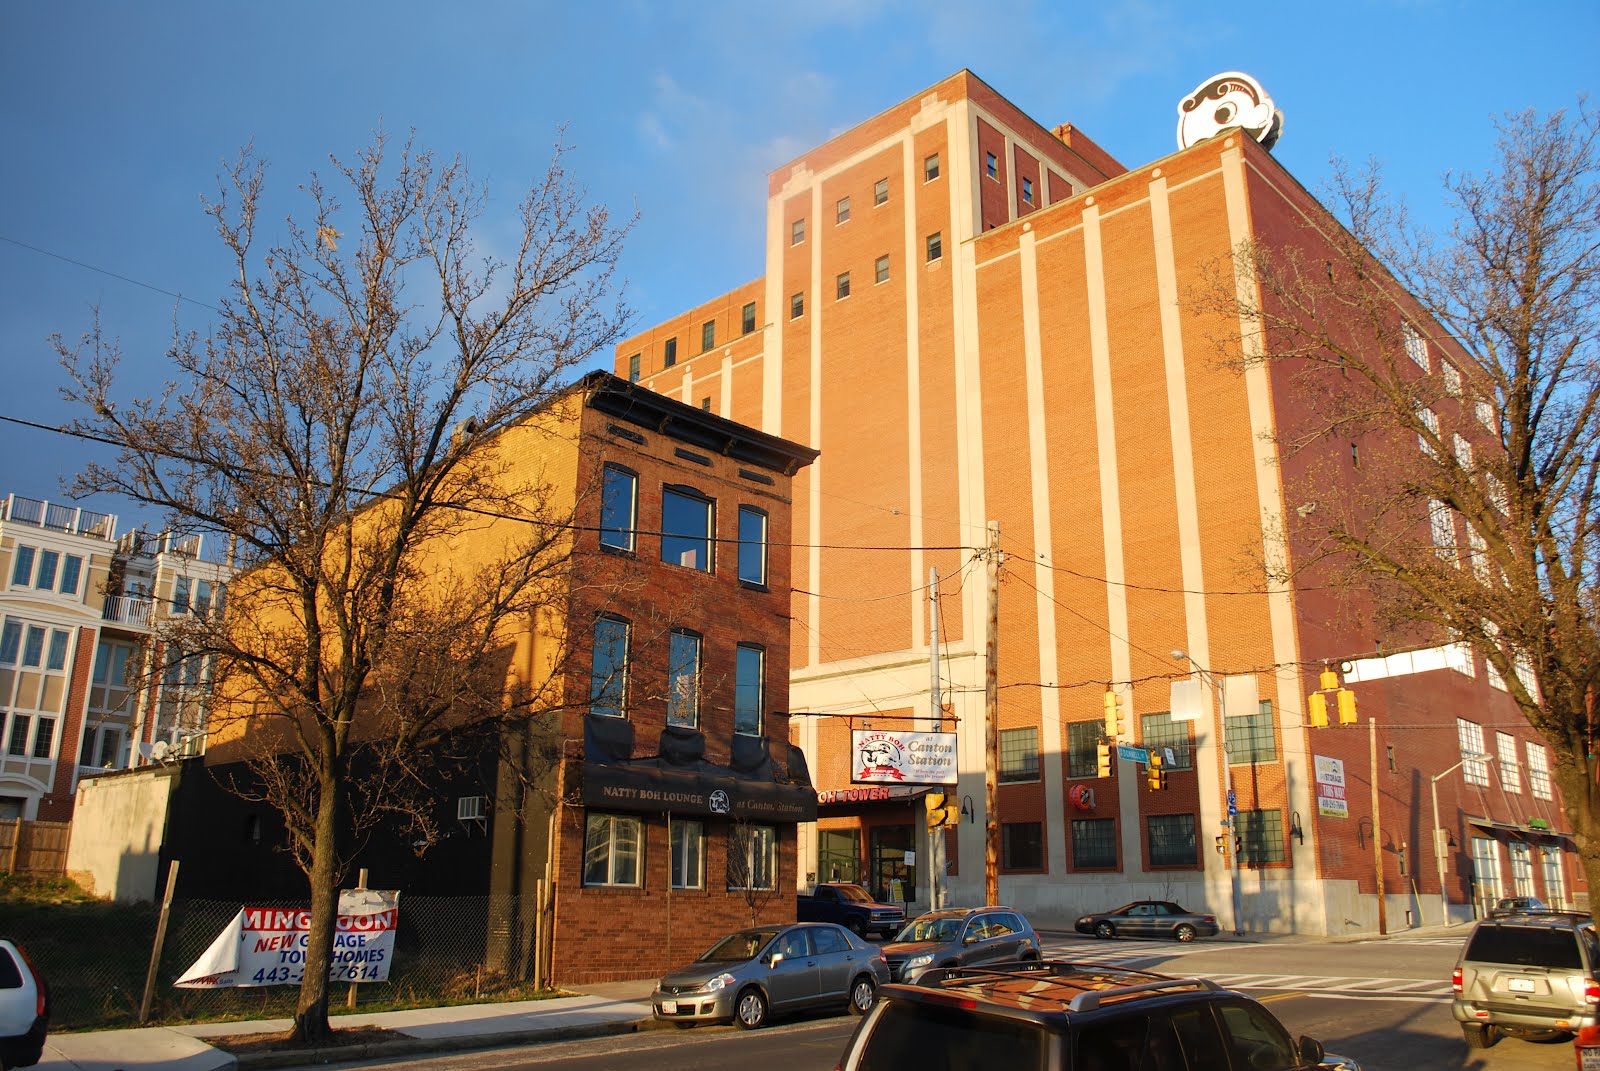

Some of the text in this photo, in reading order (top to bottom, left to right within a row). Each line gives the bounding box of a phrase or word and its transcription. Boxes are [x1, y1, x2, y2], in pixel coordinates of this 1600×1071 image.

[858, 734, 905, 751] NATTY BOH
[907, 741, 952, 752] Canton
[907, 754, 952, 766] Station
[603, 786, 703, 804] NATTY BOH LOUNGE
[817, 787, 890, 804] OH TOWER
[736, 801, 745, 809] at
[777, 803, 803, 813] Station
[242, 910, 393, 931] MING OON
[254, 933, 297, 953] NEW
[299, 934, 366, 948] GAGE
[280, 949, 385, 964] TOHOMES
